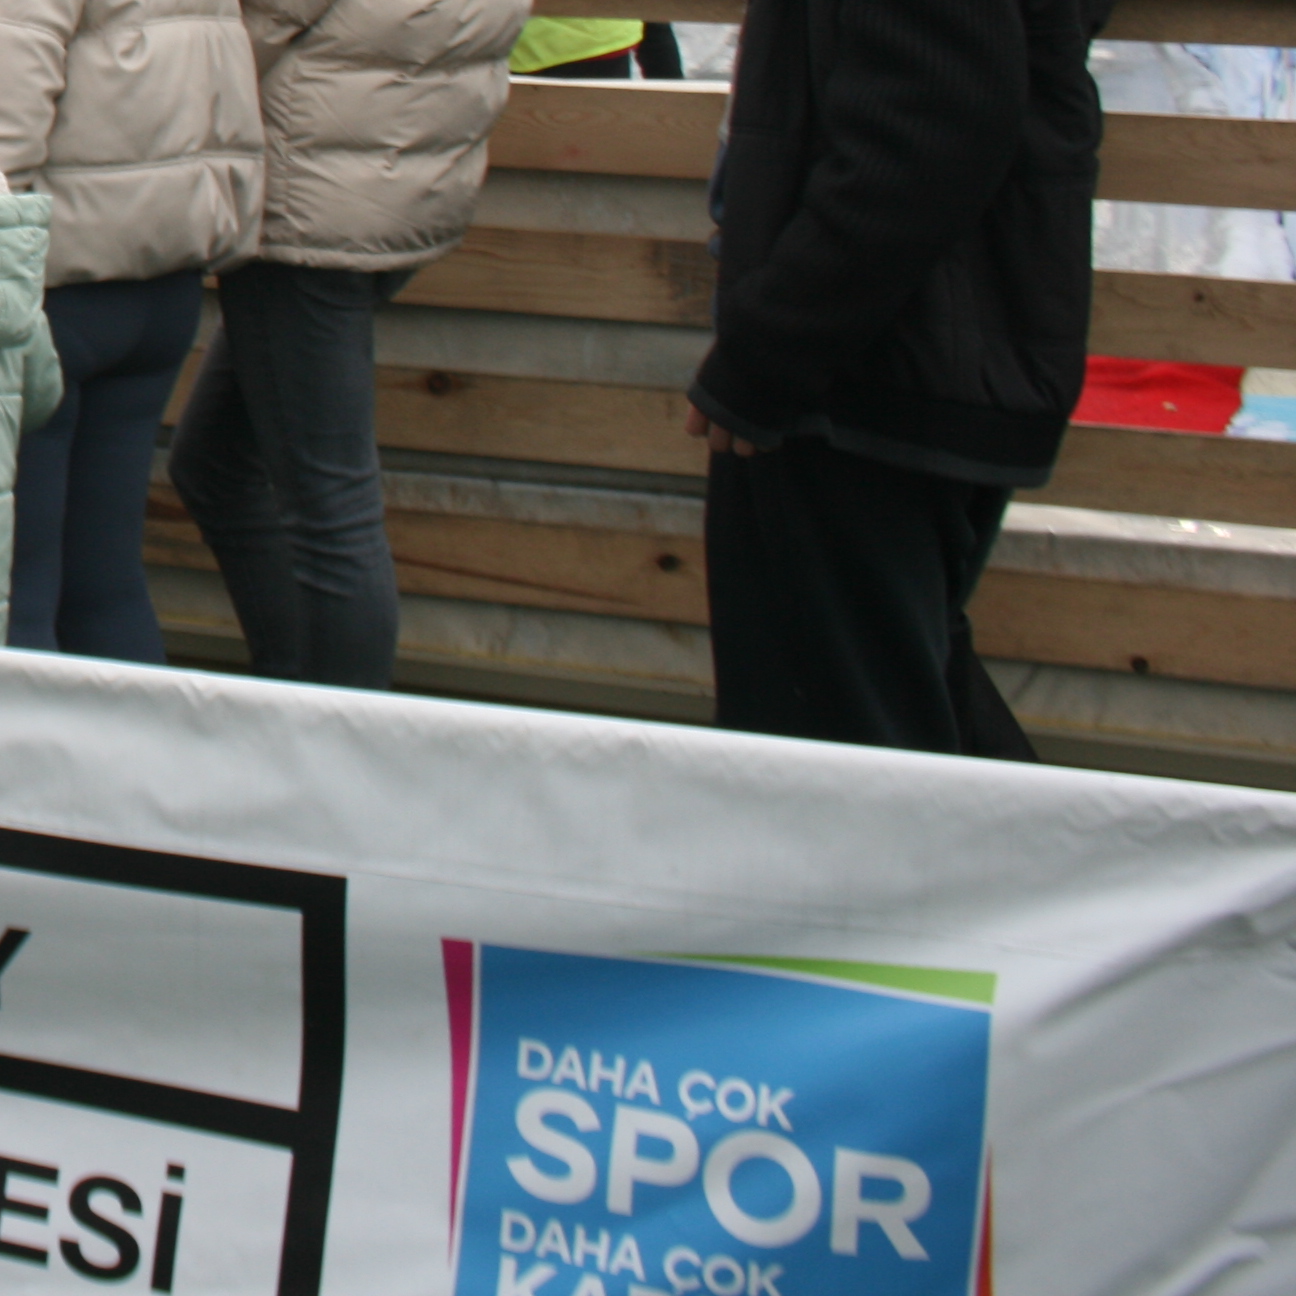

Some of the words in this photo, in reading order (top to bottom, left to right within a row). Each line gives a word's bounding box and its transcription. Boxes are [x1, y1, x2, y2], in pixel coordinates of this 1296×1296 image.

[516, 1036, 661, 1106] DAHA
[678, 1069, 795, 1132] ÇOK
[506, 1086, 933, 1262] SPOR
[498, 1207, 647, 1283] DAHA
